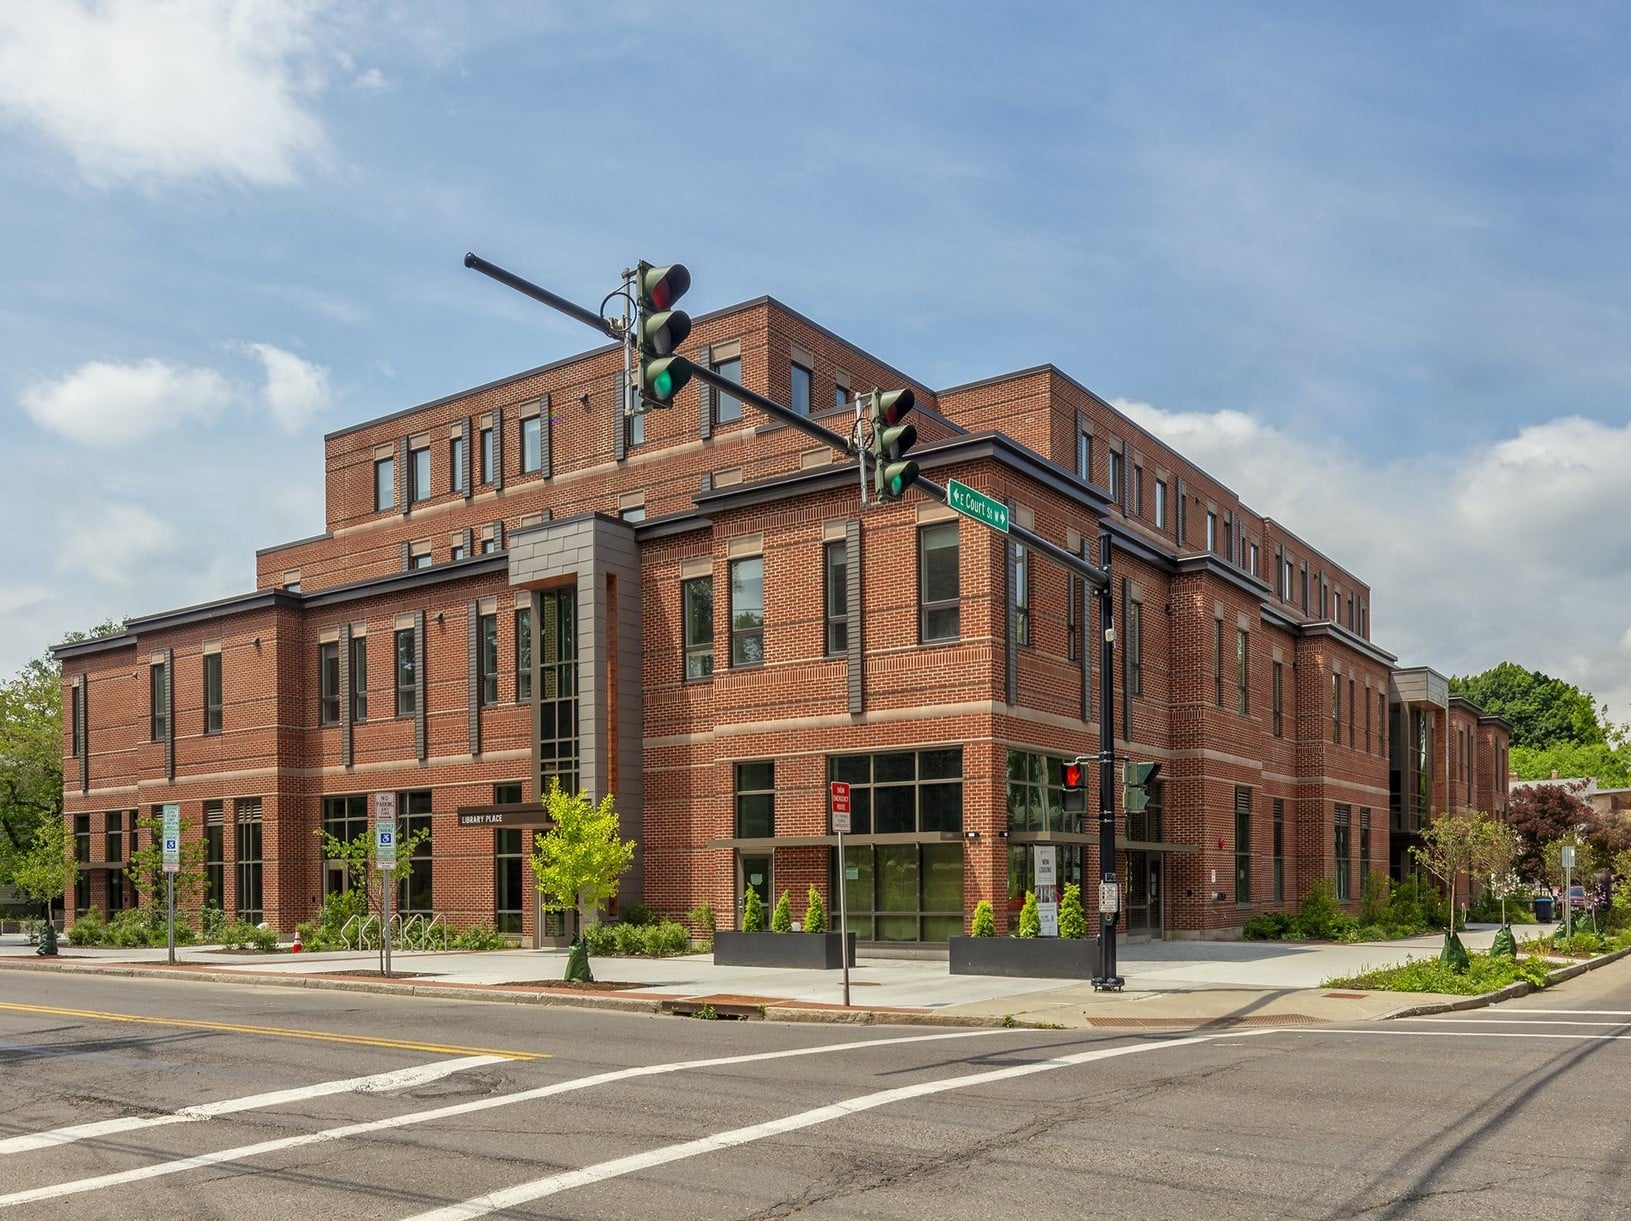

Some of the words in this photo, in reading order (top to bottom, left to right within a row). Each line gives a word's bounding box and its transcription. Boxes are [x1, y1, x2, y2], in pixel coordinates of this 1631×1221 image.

[960, 493, 964, 506] E
[965, 493, 985, 516] Court
[994, 509, 1000, 523] W
[461, 815, 485, 824] LIBRARY
[485, 814, 503, 823] PLACE
